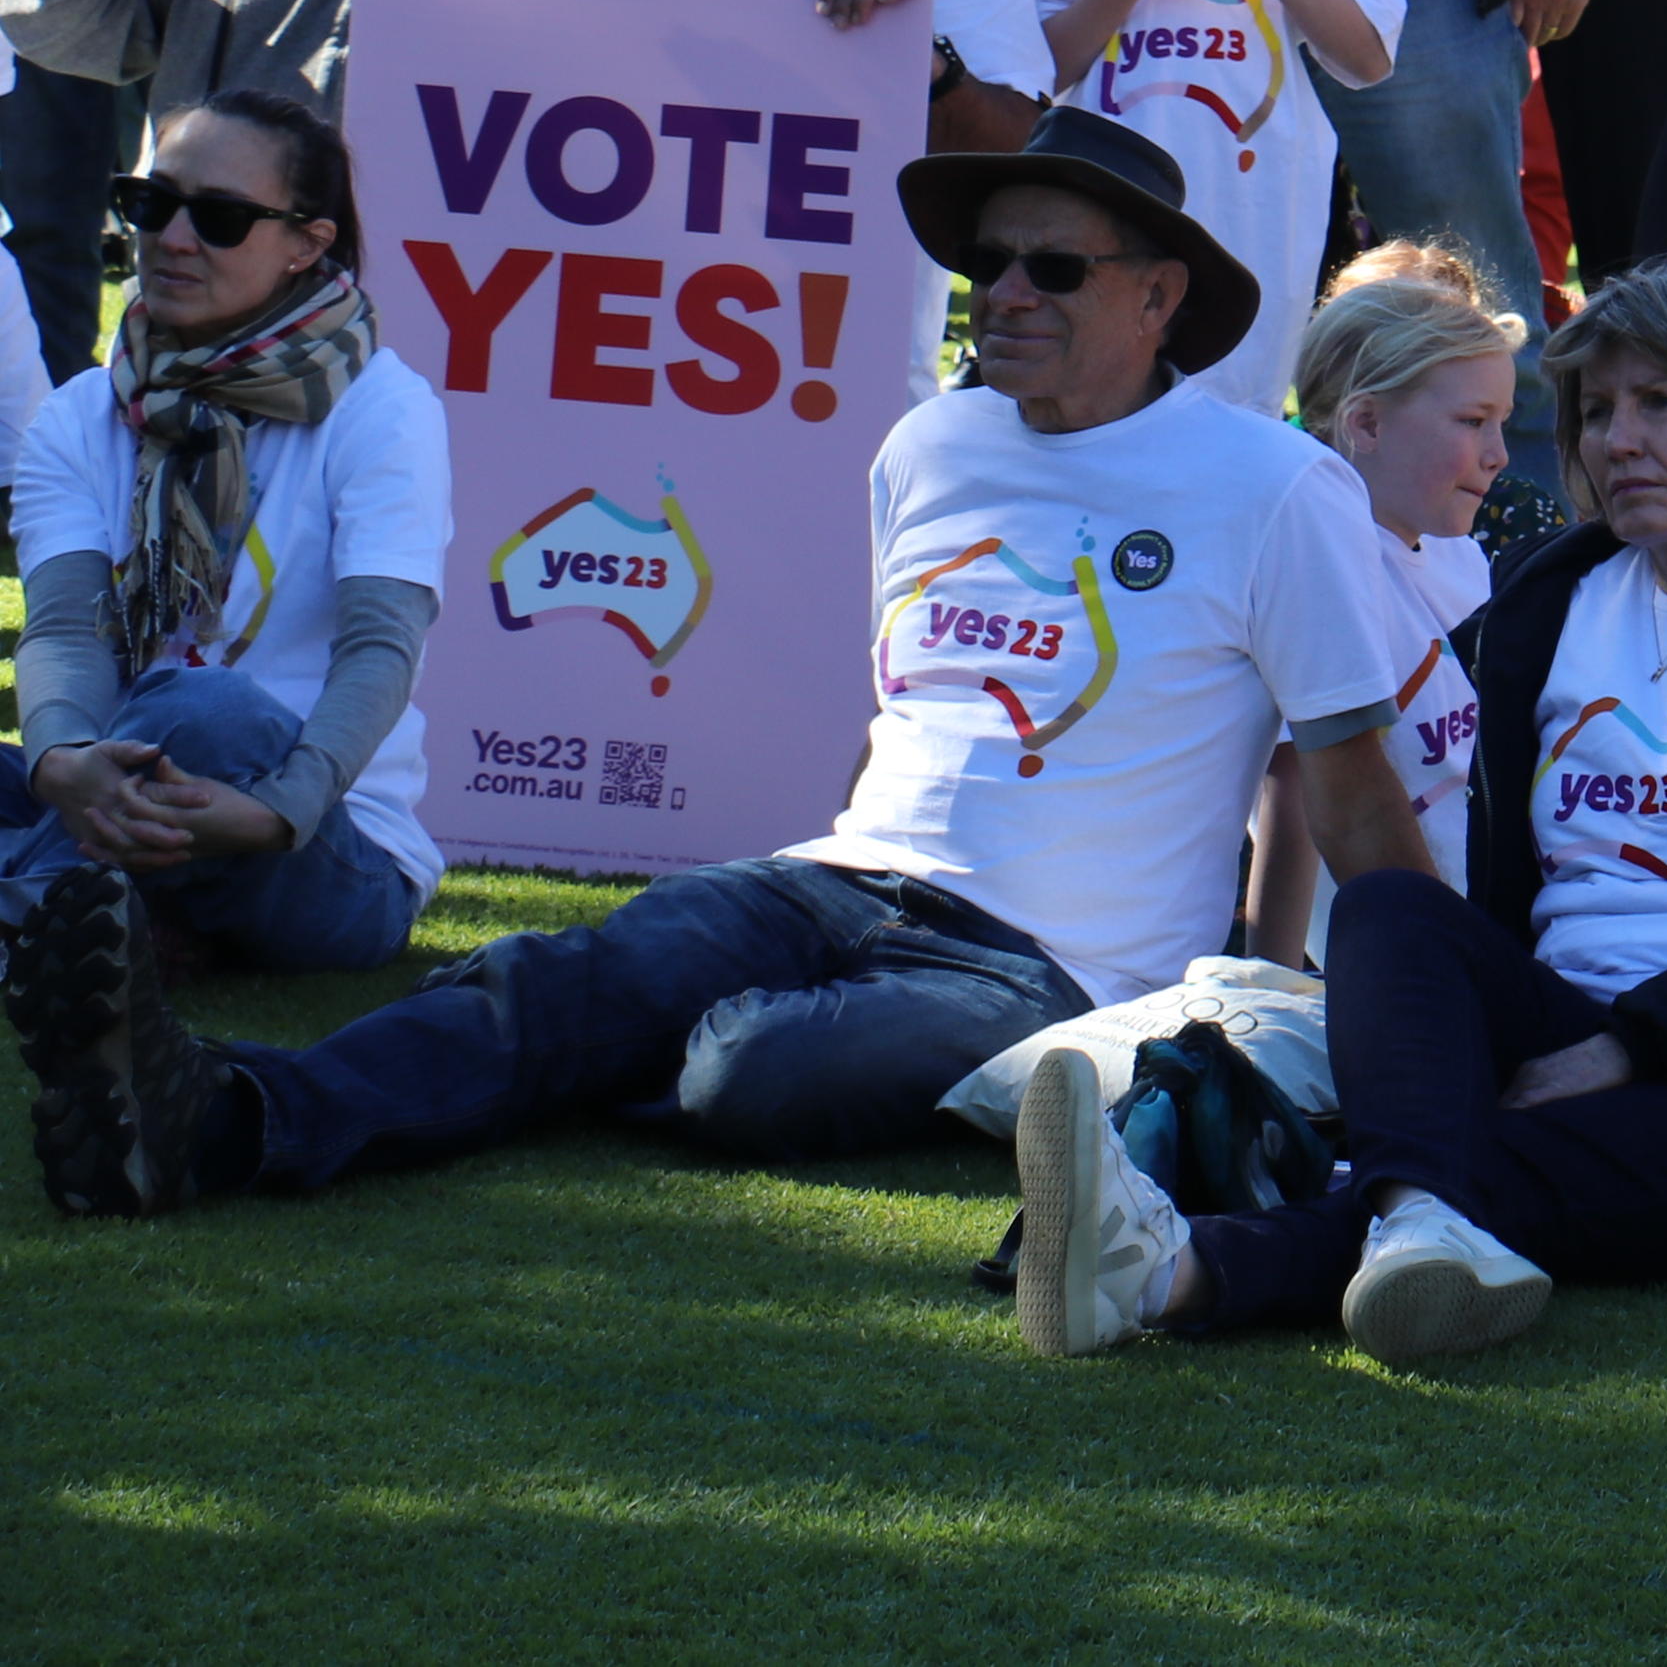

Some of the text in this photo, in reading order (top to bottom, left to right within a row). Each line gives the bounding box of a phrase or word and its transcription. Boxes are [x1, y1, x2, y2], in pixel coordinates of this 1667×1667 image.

[1119, 27, 1247, 74] yes23
[415, 83, 860, 245] VOTE
[402, 239, 850, 424] YES!
[537, 548, 668, 590] yes23
[1126, 549, 1157, 569] Yes
[918, 602, 1064, 661] yes23
[472, 729, 588, 771] Yes23
[465, 771, 584, 801] .com.au
